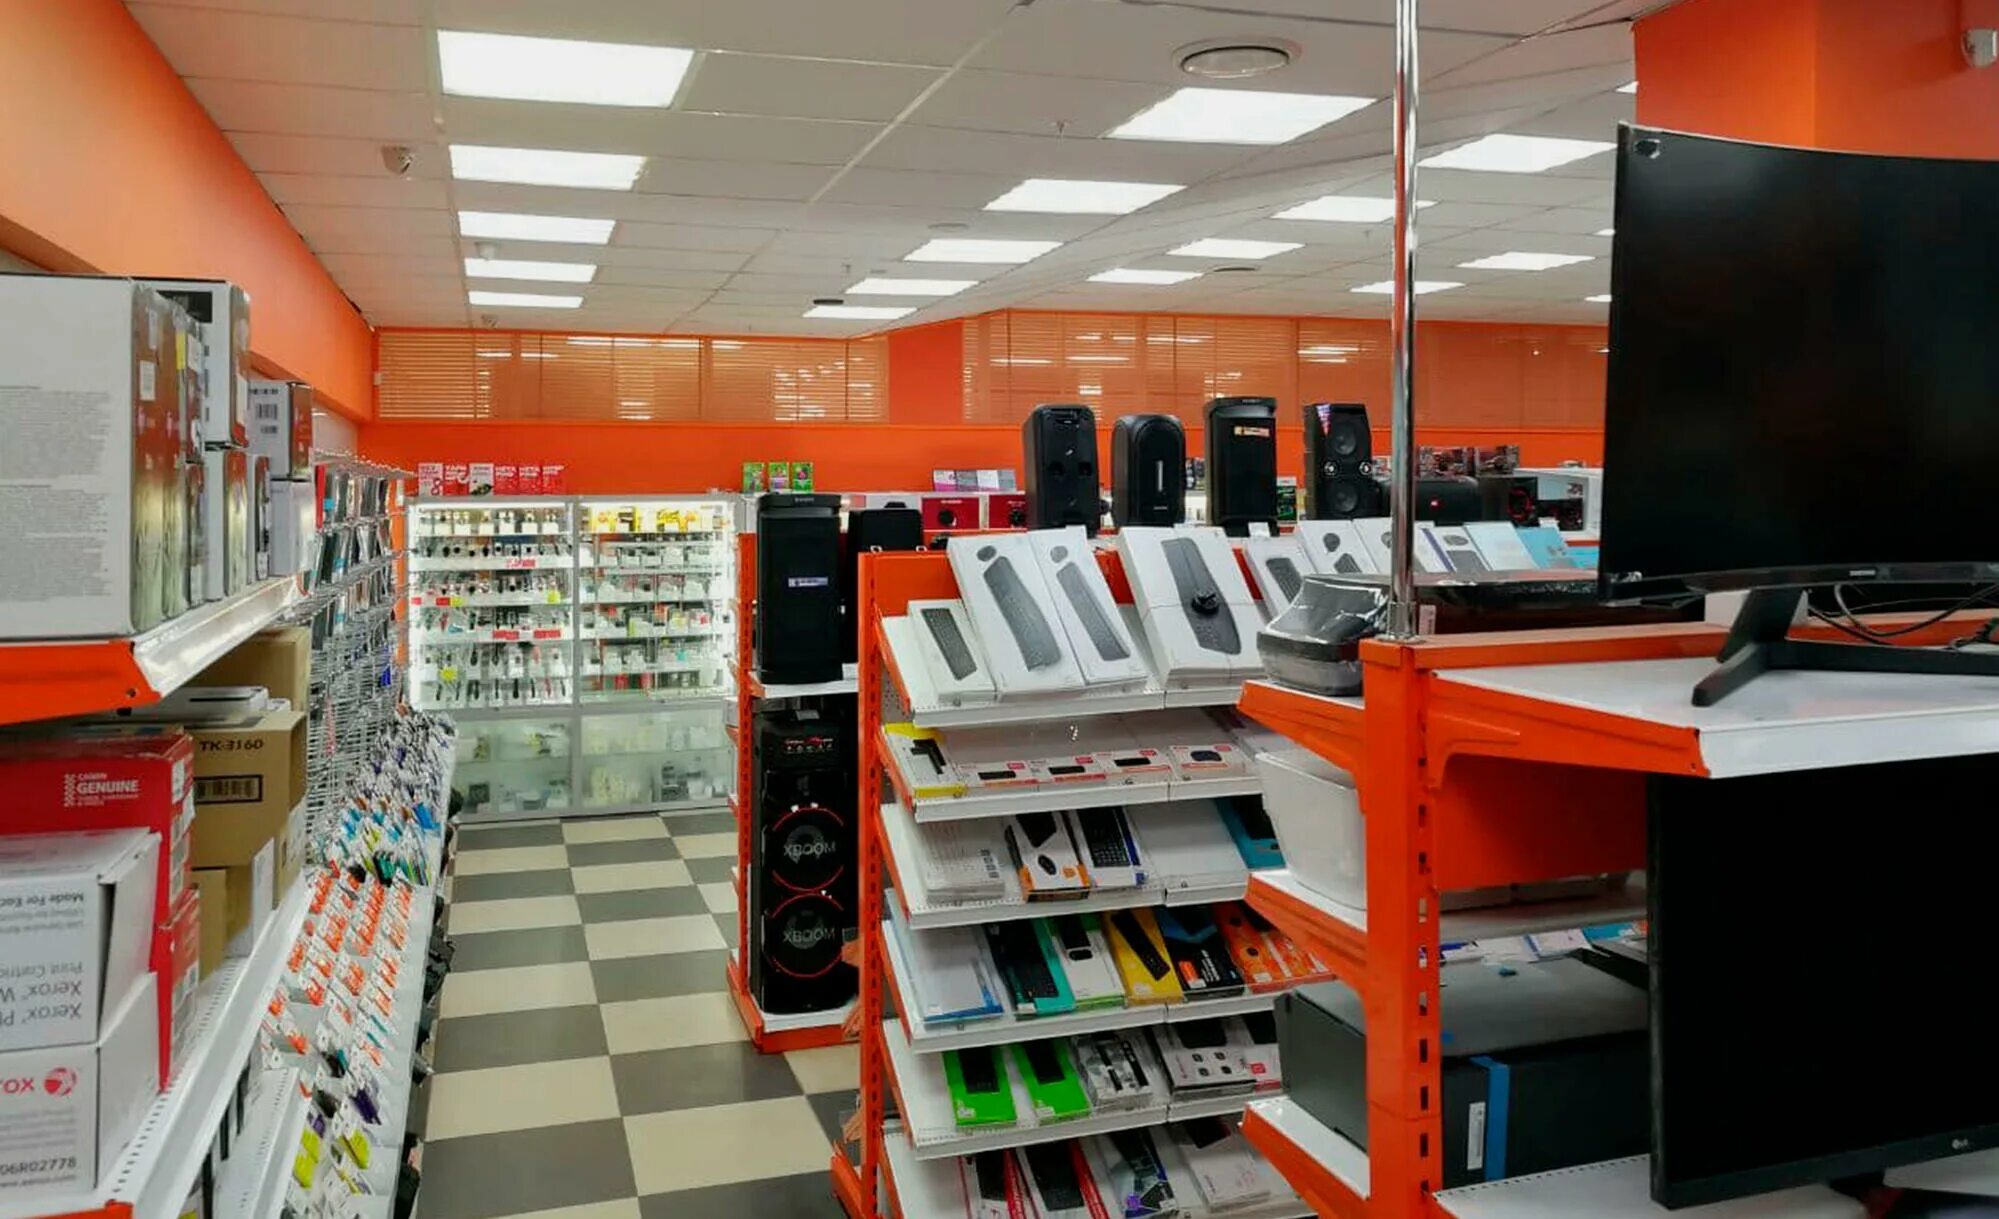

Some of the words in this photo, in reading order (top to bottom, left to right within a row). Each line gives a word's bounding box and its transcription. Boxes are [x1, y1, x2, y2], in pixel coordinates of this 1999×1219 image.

[199, 739, 264, 751] TK-3160
[77, 780, 140, 794] GENUINE
[783, 841, 836, 856] XBOOM
[26, 896, 46, 907] For
[49, 893, 84, 903] Made
[783, 927, 835, 942] XBOOM
[50, 961, 83, 974] Print
[0, 1077, 34, 1094] ox
